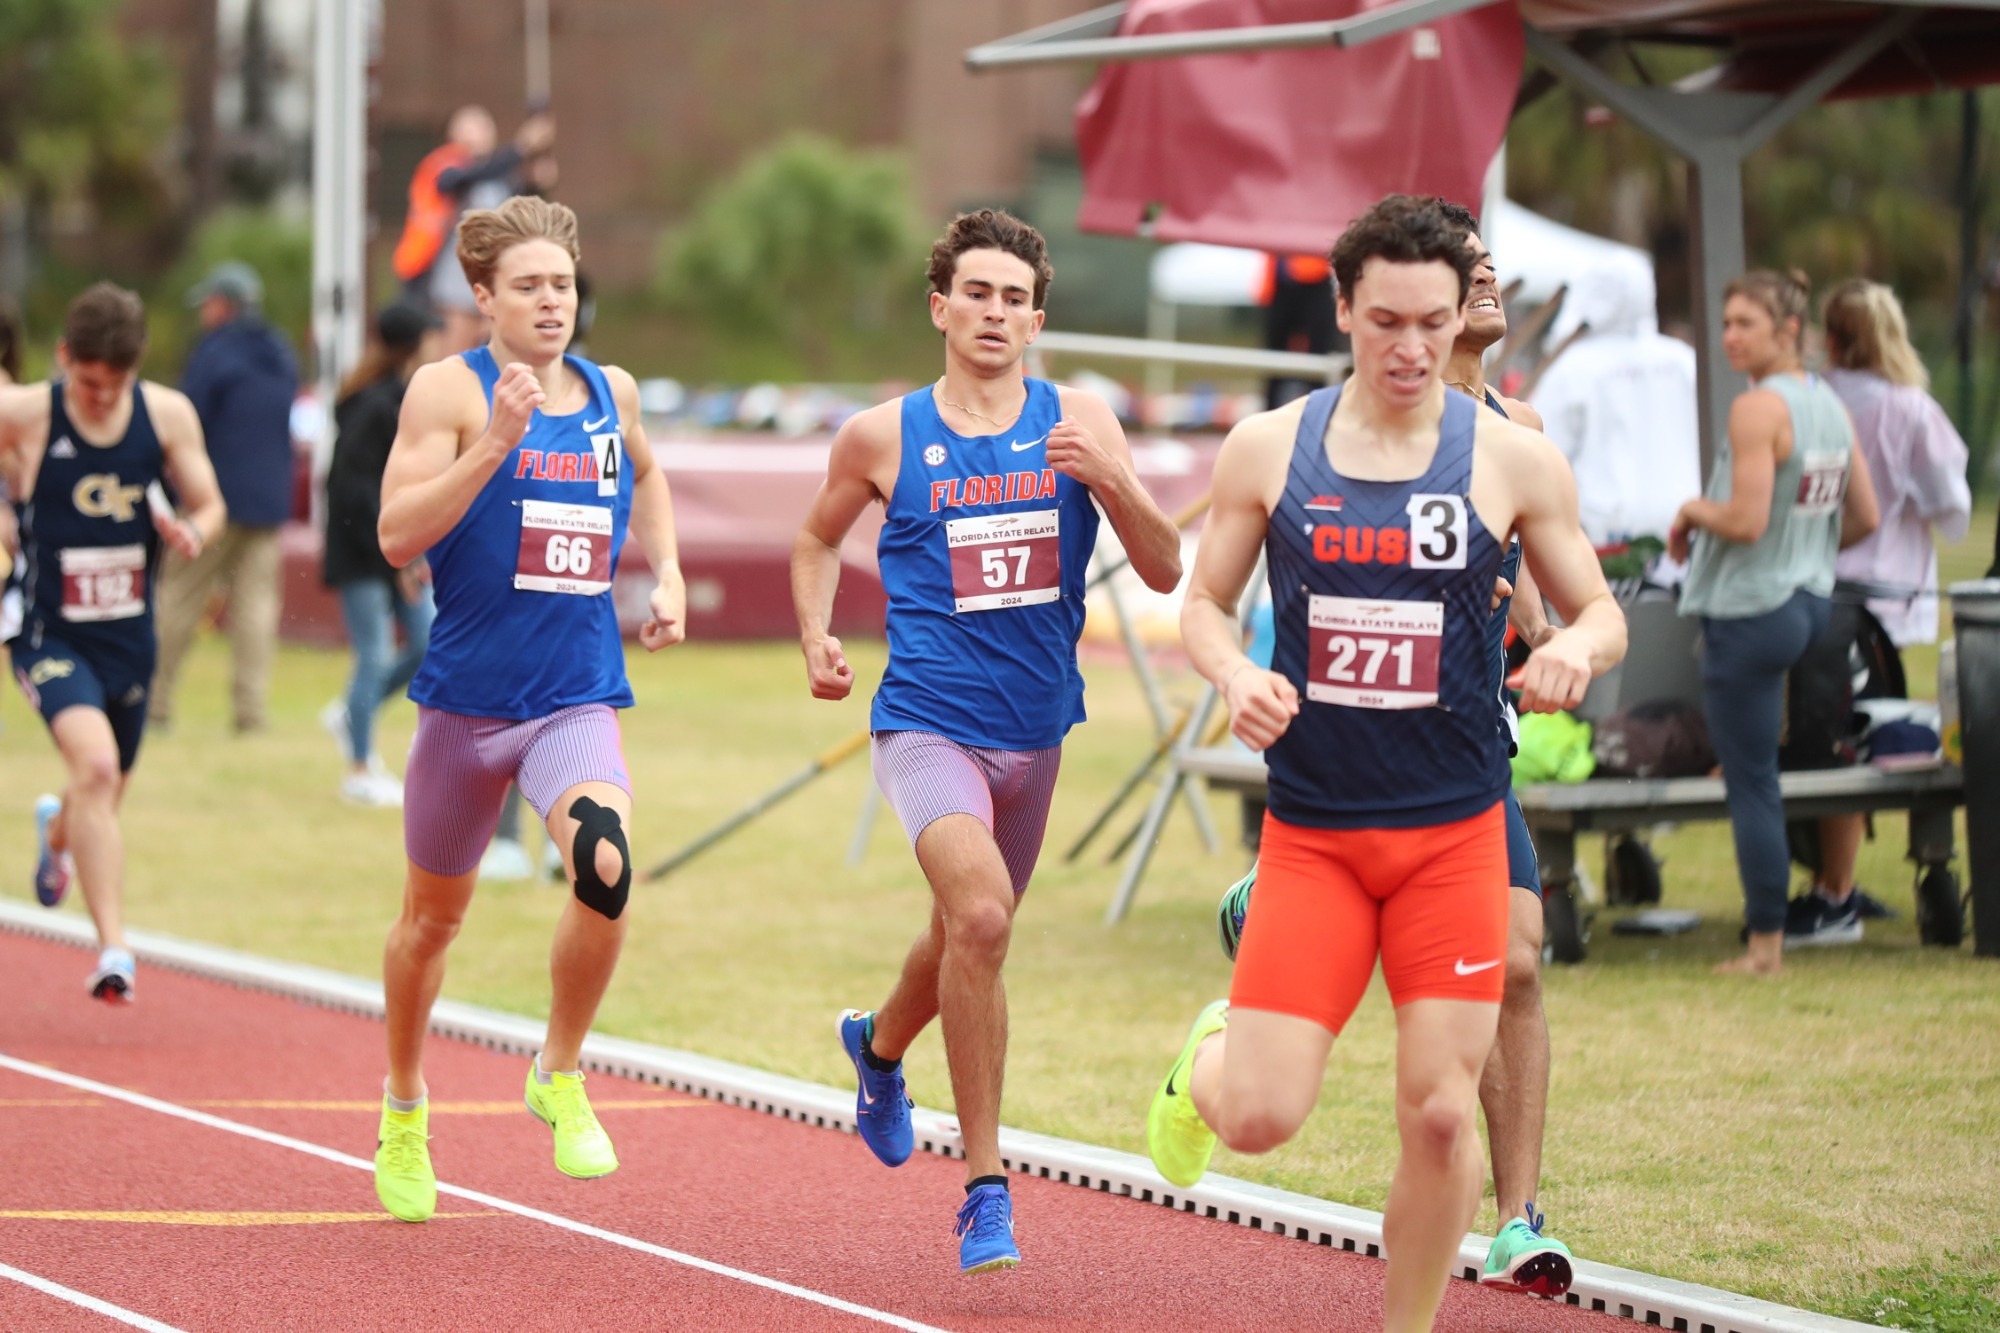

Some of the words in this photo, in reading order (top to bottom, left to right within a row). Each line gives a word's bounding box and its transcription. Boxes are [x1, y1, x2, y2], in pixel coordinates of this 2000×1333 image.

[513, 448, 600, 482] FLORI
[602, 437, 618, 491] 4
[924, 445, 947, 466] SEC
[929, 469, 1057, 513] FLORIDA
[524, 516, 558, 526] FLORIDA
[561, 519, 585, 528] STATE
[949, 532, 990, 544] FLORIDA
[992, 529, 1023, 539] STATE
[1024, 525, 1056, 536] RELAYS
[1419, 499, 1458, 563] 3
[545, 533, 593, 576] 66
[1304, 524, 1412, 565] 'CUS
[981, 545, 1031, 588] 57
[555, 582, 577, 592] 2024
[1000, 596, 1023, 606] 2024
[1312, 614, 1357, 626] FLORIDA
[1361, 618, 1395, 628] STATE
[1326, 634, 1414, 687] 271
